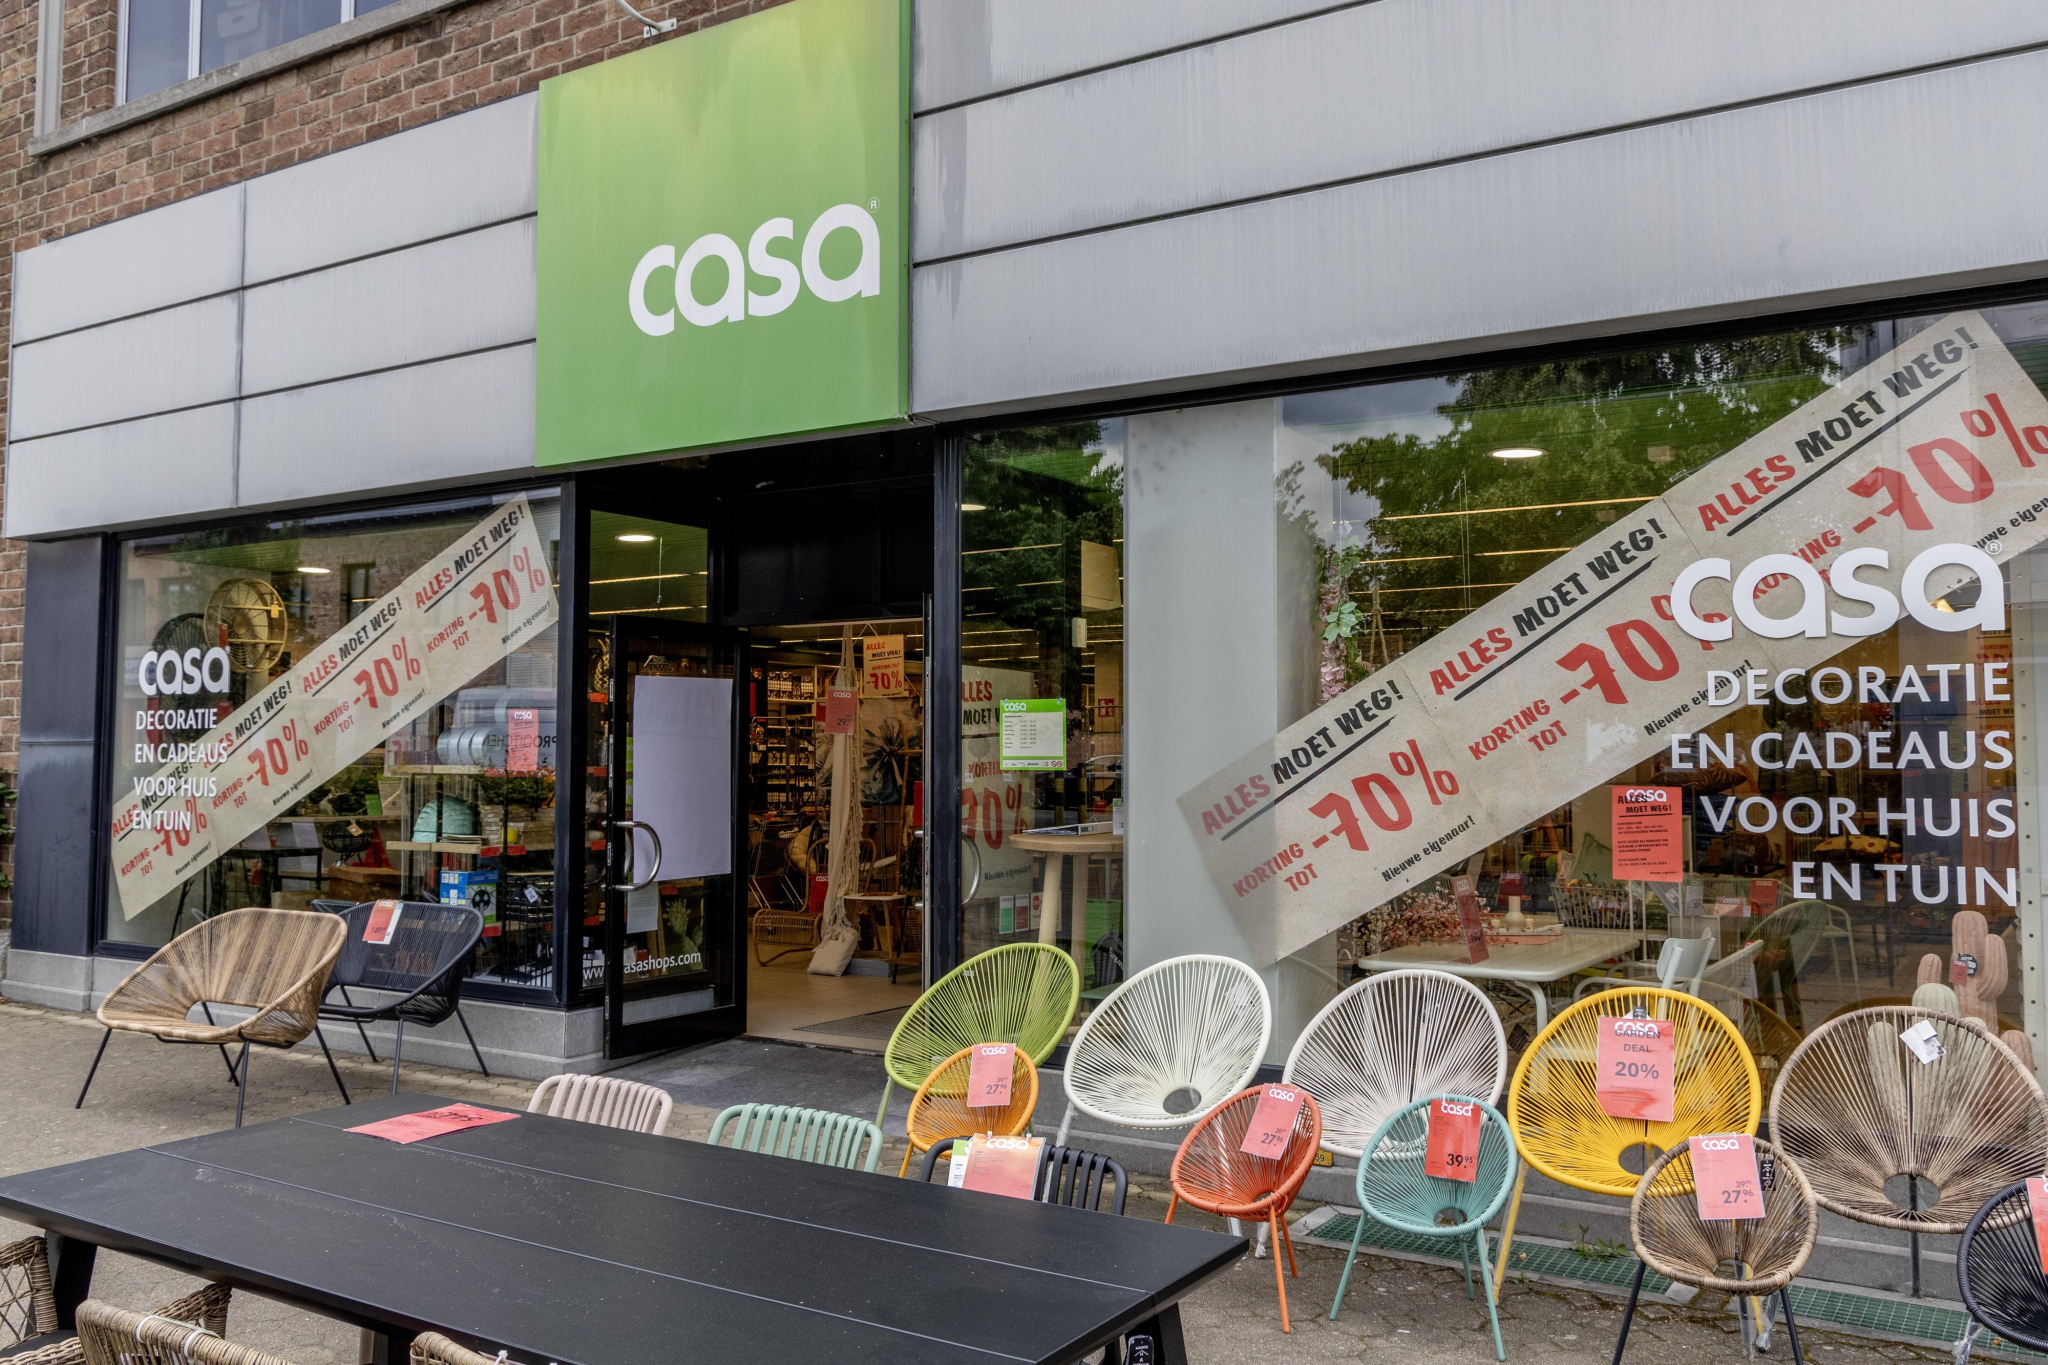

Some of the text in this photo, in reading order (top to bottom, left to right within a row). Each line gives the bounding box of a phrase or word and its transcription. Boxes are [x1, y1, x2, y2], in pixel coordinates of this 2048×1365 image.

[628, 203, 881, 337] casa
[1698, 326, 1980, 532] ALLES MOET WEG!
[1847, 392, 2048, 532] -70%
[415, 504, 525, 609] ALLES MOET WEG!
[468, 546, 546, 624] -70%
[1670, 542, 2006, 641] casa
[1429, 517, 1668, 696] ALLES MOET WEG!
[303, 596, 403, 693] ALLES MOET WEG!
[427, 616, 464, 653] KORTING
[452, 630, 470, 650] TOT
[139, 646, 231, 696] casa
[353, 636, 421, 709] -70%
[866, 670, 903, 691] -70%
[833, 691, 851, 699] casa
[962, 679, 993, 702] LLES
[1707, 661, 2011, 707] DECORATIE
[1003, 702, 1027, 711] casa
[1644, 659, 1754, 736] Nieuwe eigenar!
[135, 708, 218, 731] DECORATIE
[234, 706, 262, 741] MOET
[263, 680, 292, 714] WEG!
[314, 701, 349, 735] KORTING
[963, 707, 992, 726] MOET
[338, 715, 354, 734] TOT
[1468, 699, 1550, 761] KORTING
[1527, 719, 1568, 752] TOT
[134, 743, 228, 764] EN CADEAUS
[246, 718, 309, 787] -70%
[1200, 679, 1404, 836] ALLES MOET WEG!
[1671, 732, 1734, 769] EN
[1750, 730, 2014, 771] CADEAUS
[968, 760, 1008, 778] KORTIN
[133, 776, 218, 798] VOOR HUIS
[212, 777, 243, 810] KORTING
[1308, 738, 1460, 852] -70%
[1626, 789, 1667, 802] casa
[233, 791, 248, 809] TOT
[1617, 794, 1648, 804] ALLES
[1626, 804, 1672, 813] MOET WEG!
[132, 810, 191, 831] EN TUIN
[1700, 795, 2016, 838] VOOR HUIS
[1381, 815, 1476, 883] Nieuwe eigenaar!
[121, 847, 150, 877] KORTING
[140, 861, 154, 877] TOT
[1232, 842, 1304, 899] KORTING
[1284, 863, 1318, 893] TOT
[1792, 861, 2018, 907] EN TUIN
[1614, 1021, 1658, 1036] casa
[1615, 1028, 1661, 1040] GARDEN
[981, 1046, 1007, 1056] casa
[1623, 1043, 1652, 1053] DEAL
[1615, 1061, 1660, 1079] 20%
[986, 1084, 1007, 1094] 27.96
[1269, 1088, 1295, 1102] casa
[1441, 1103, 1472, 1117] casa
[986, 1138, 1029, 1150] casa
[1261, 1132, 1283, 1147] 27.96
[1702, 1139, 1739, 1151] casa
[1446, 1153, 1473, 1168] 39.95
[1721, 1189, 1754, 1204] 27.96
